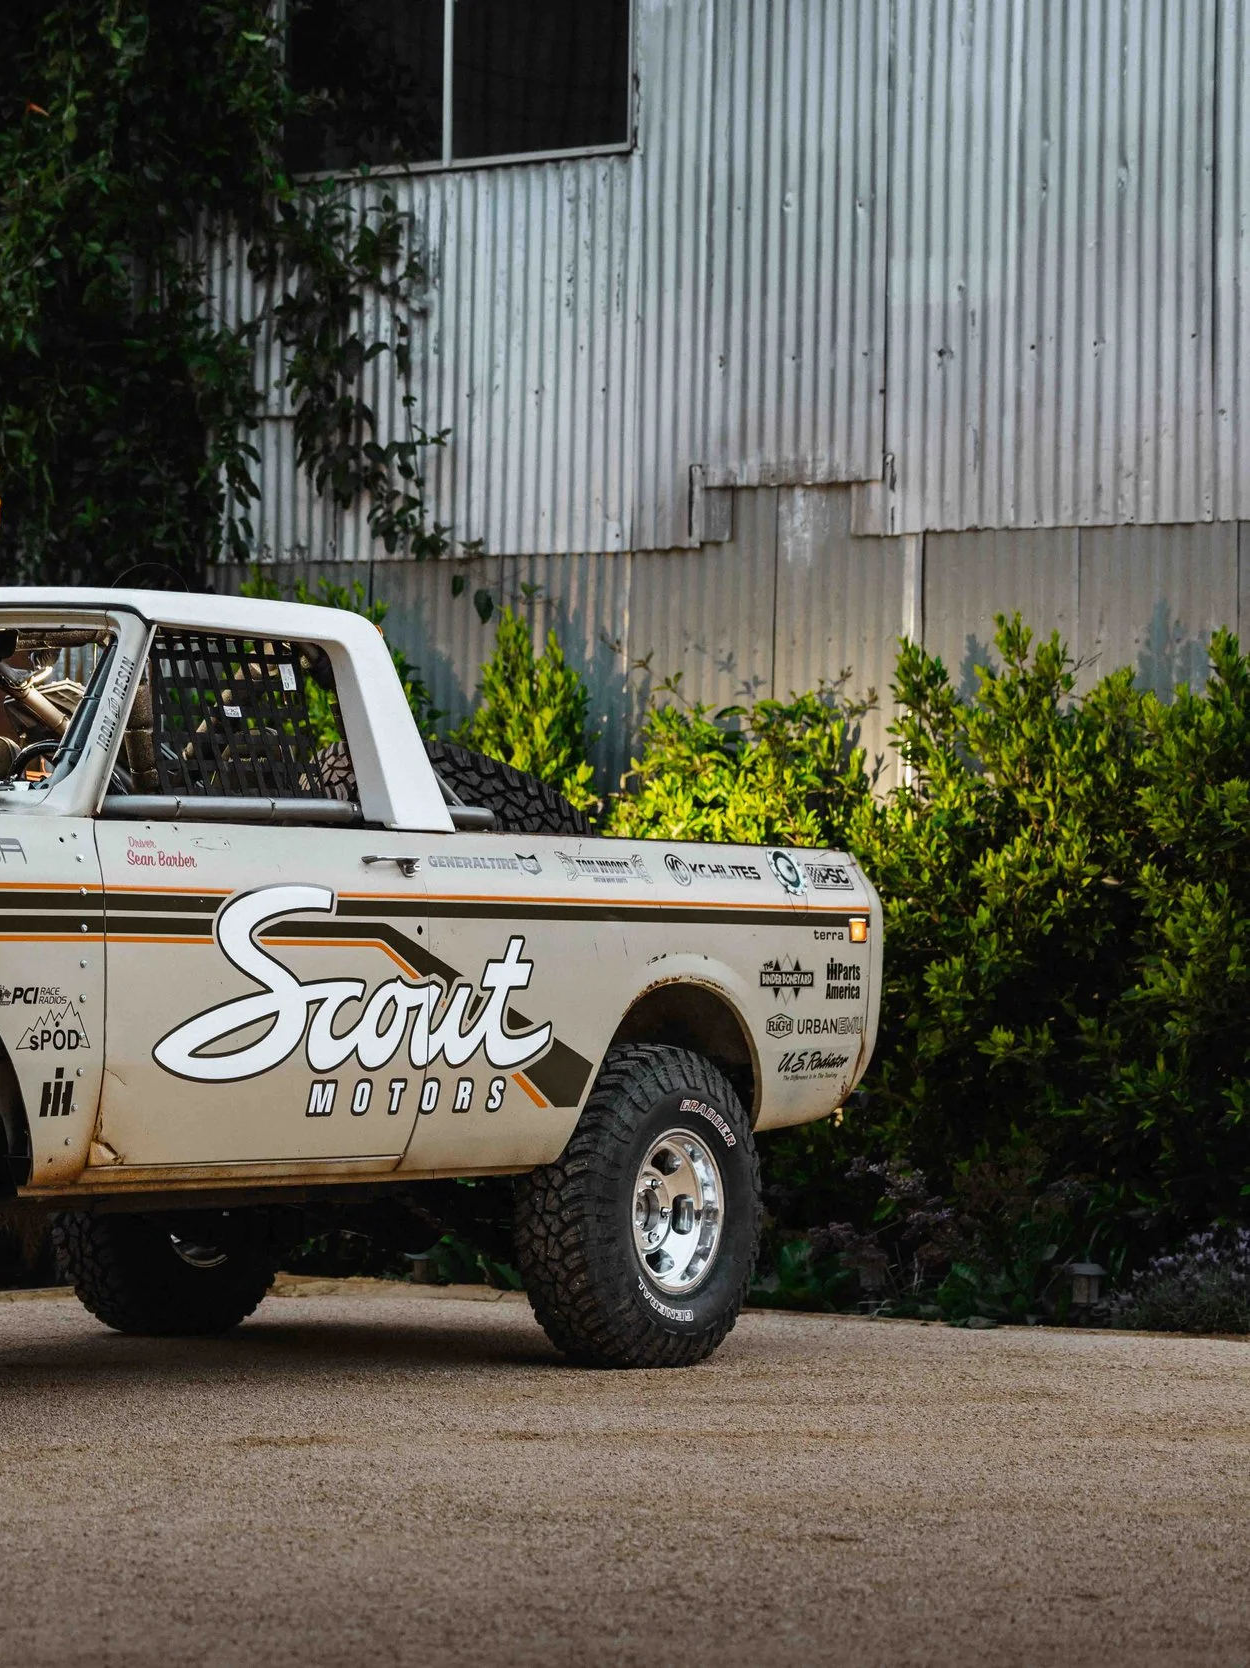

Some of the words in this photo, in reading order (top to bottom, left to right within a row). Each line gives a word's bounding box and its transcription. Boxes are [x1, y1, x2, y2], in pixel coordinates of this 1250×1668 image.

[96, 715, 116, 752] IRON
[113, 656, 135, 700] RESIN
[128, 836, 157, 848] Driver
[127, 849, 156, 866] Sean
[157, 850, 197, 868] Barber
[575, 859, 600, 873] TOM
[595, 860, 634, 875] WOOD'S
[689, 864, 711, 878] KC
[817, 868, 849, 884] PSC
[813, 929, 844, 940] terra
[763, 961, 774, 971] THE
[152, 883, 551, 1083] Scout
[761, 973, 783, 985] BINDER
[782, 973, 812, 985] BONEYARD
[11, 987, 39, 1004] PCI
[40, 987, 61, 995] RACE
[825, 983, 861, 999] America
[39, 996, 67, 1005] RADIOS
[30, 1029, 79, 1051] sPOD
[778, 1052, 808, 1073] U.S.
[806, 1051, 849, 1071] Radiator
[306, 1076, 506, 1117] MOTORS
[680, 1099, 737, 1147] GRABBER
[638, 1276, 694, 1321] GENERAL
